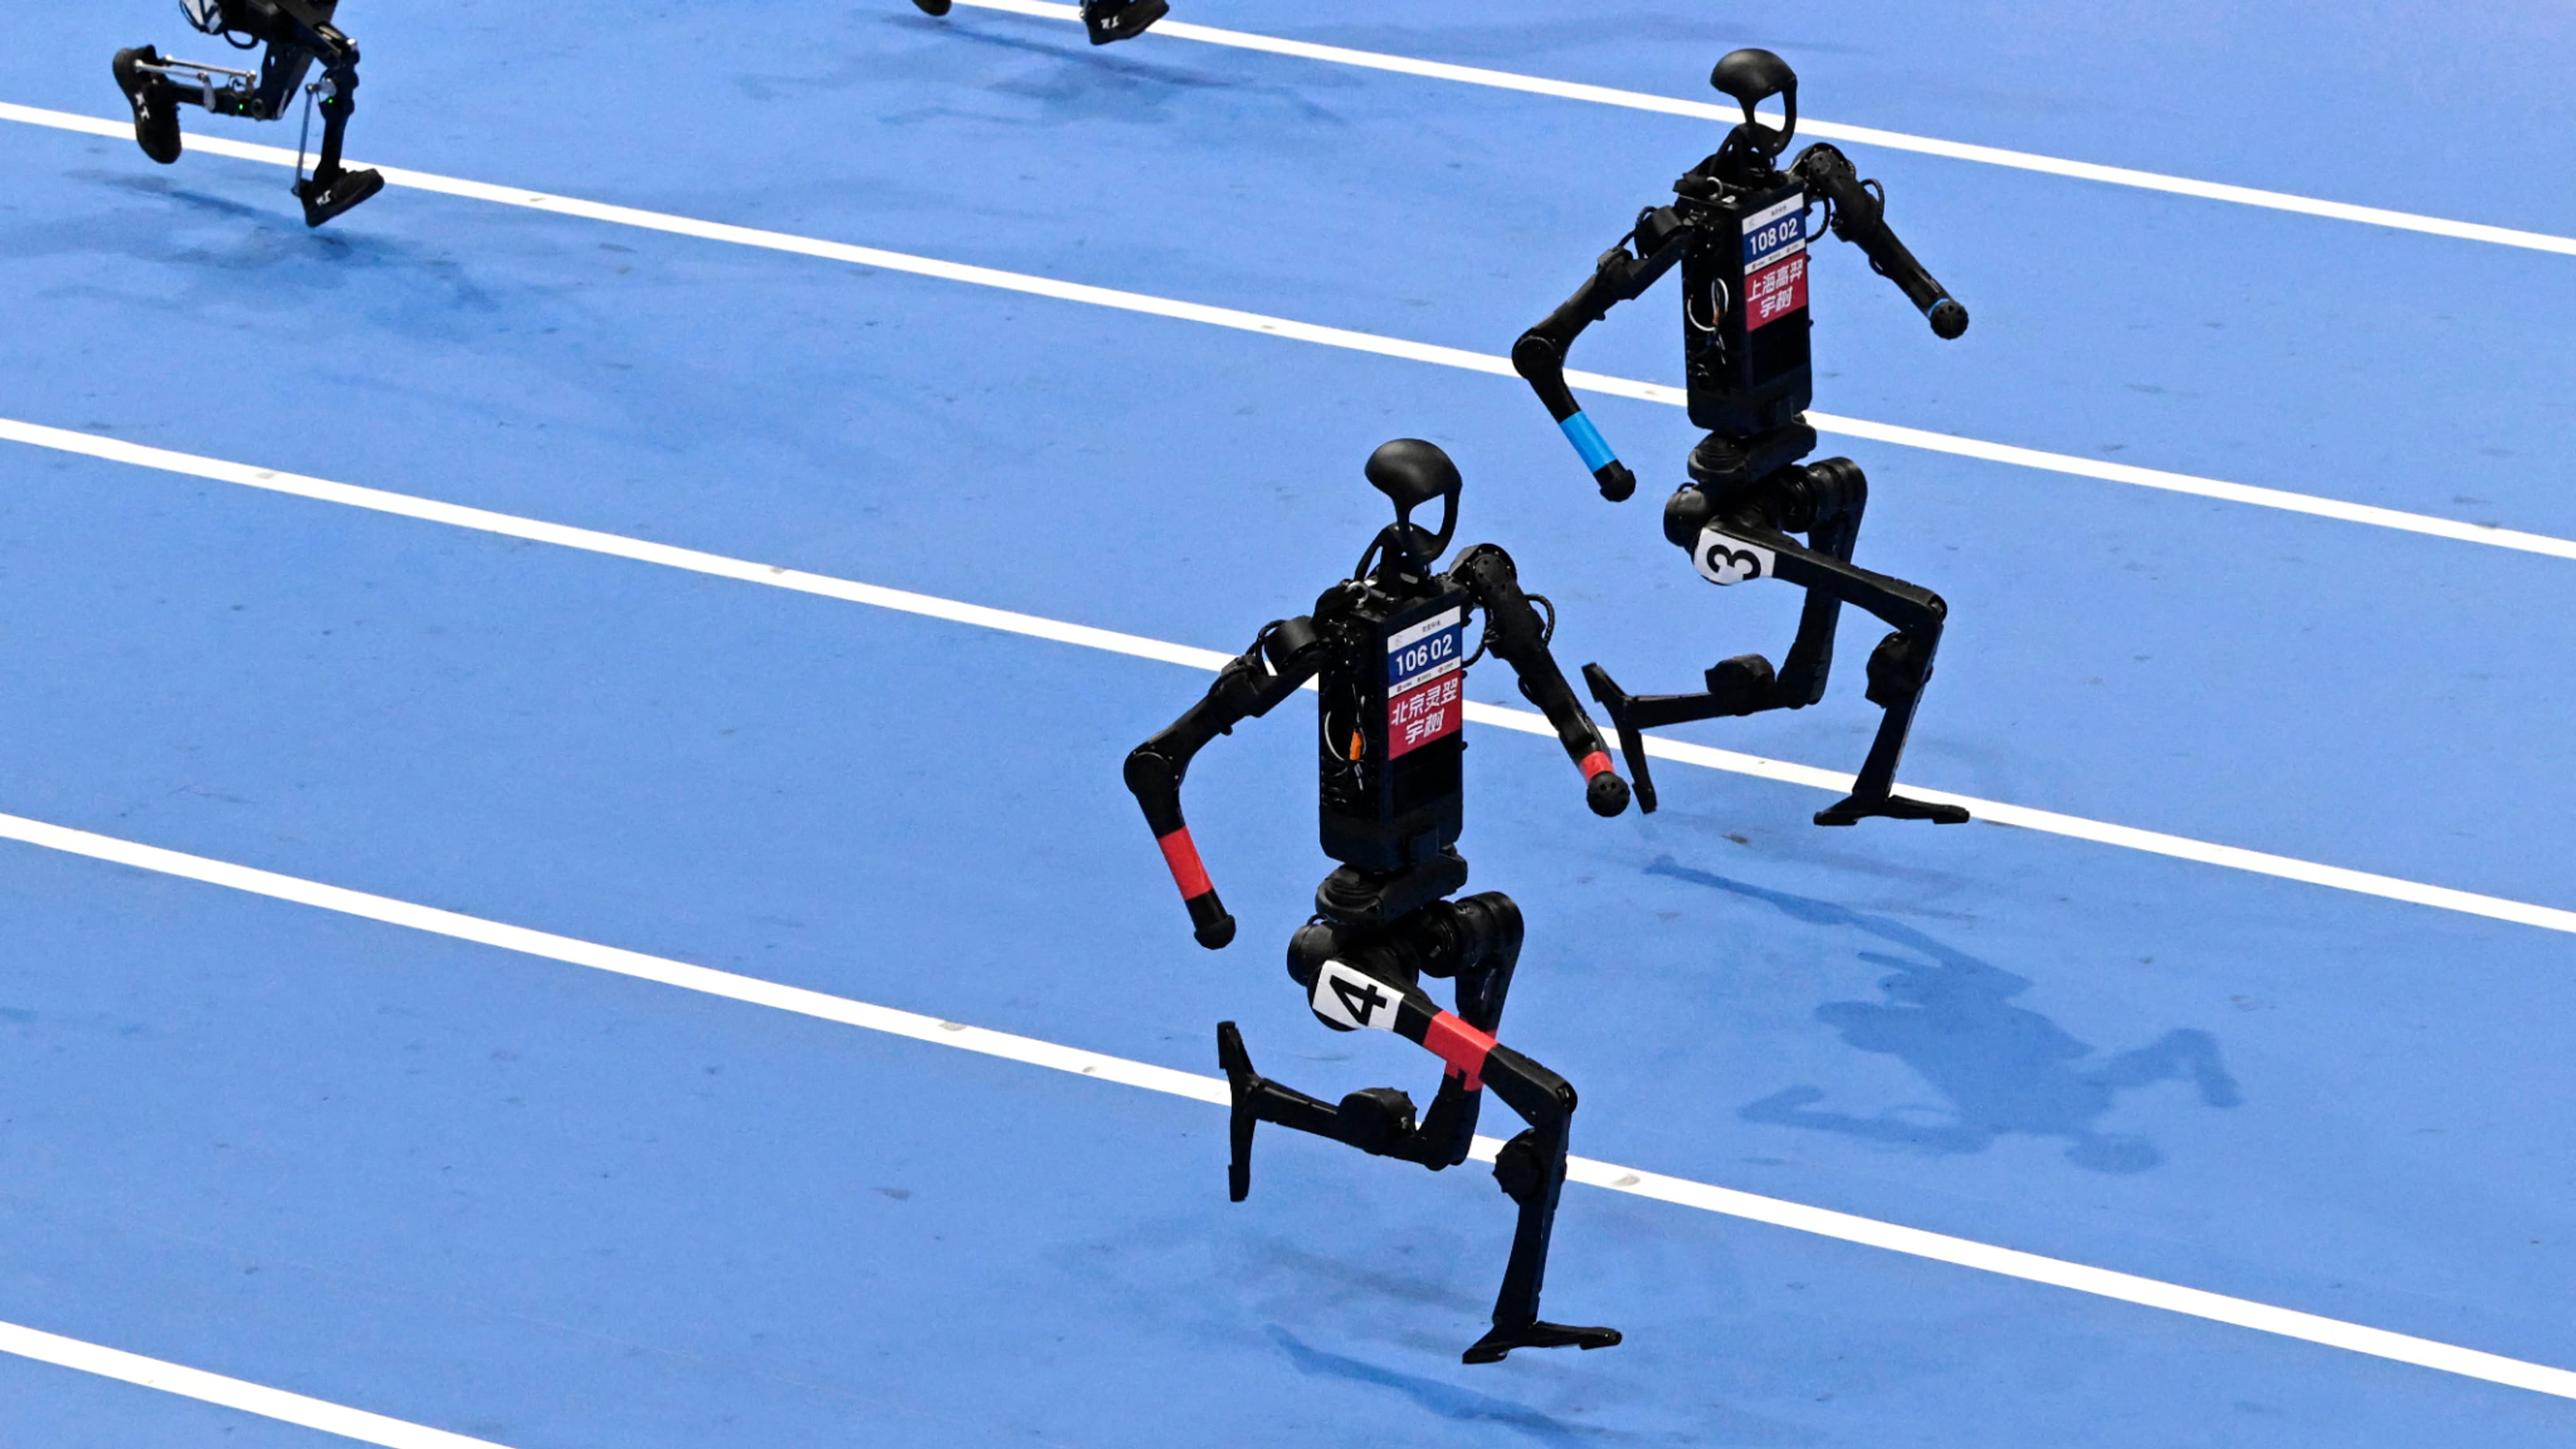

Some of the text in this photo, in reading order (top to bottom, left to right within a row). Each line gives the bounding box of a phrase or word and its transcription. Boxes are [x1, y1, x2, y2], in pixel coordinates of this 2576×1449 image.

[1748, 258, 1803, 302] 上海高羿
[1760, 286, 1792, 318] 宇树
[1706, 544, 1762, 581] 3
[1391, 677, 1458, 725] 北京灵翌
[1405, 708, 1445, 745] 宇树
[1330, 975, 1387, 1026] 4
